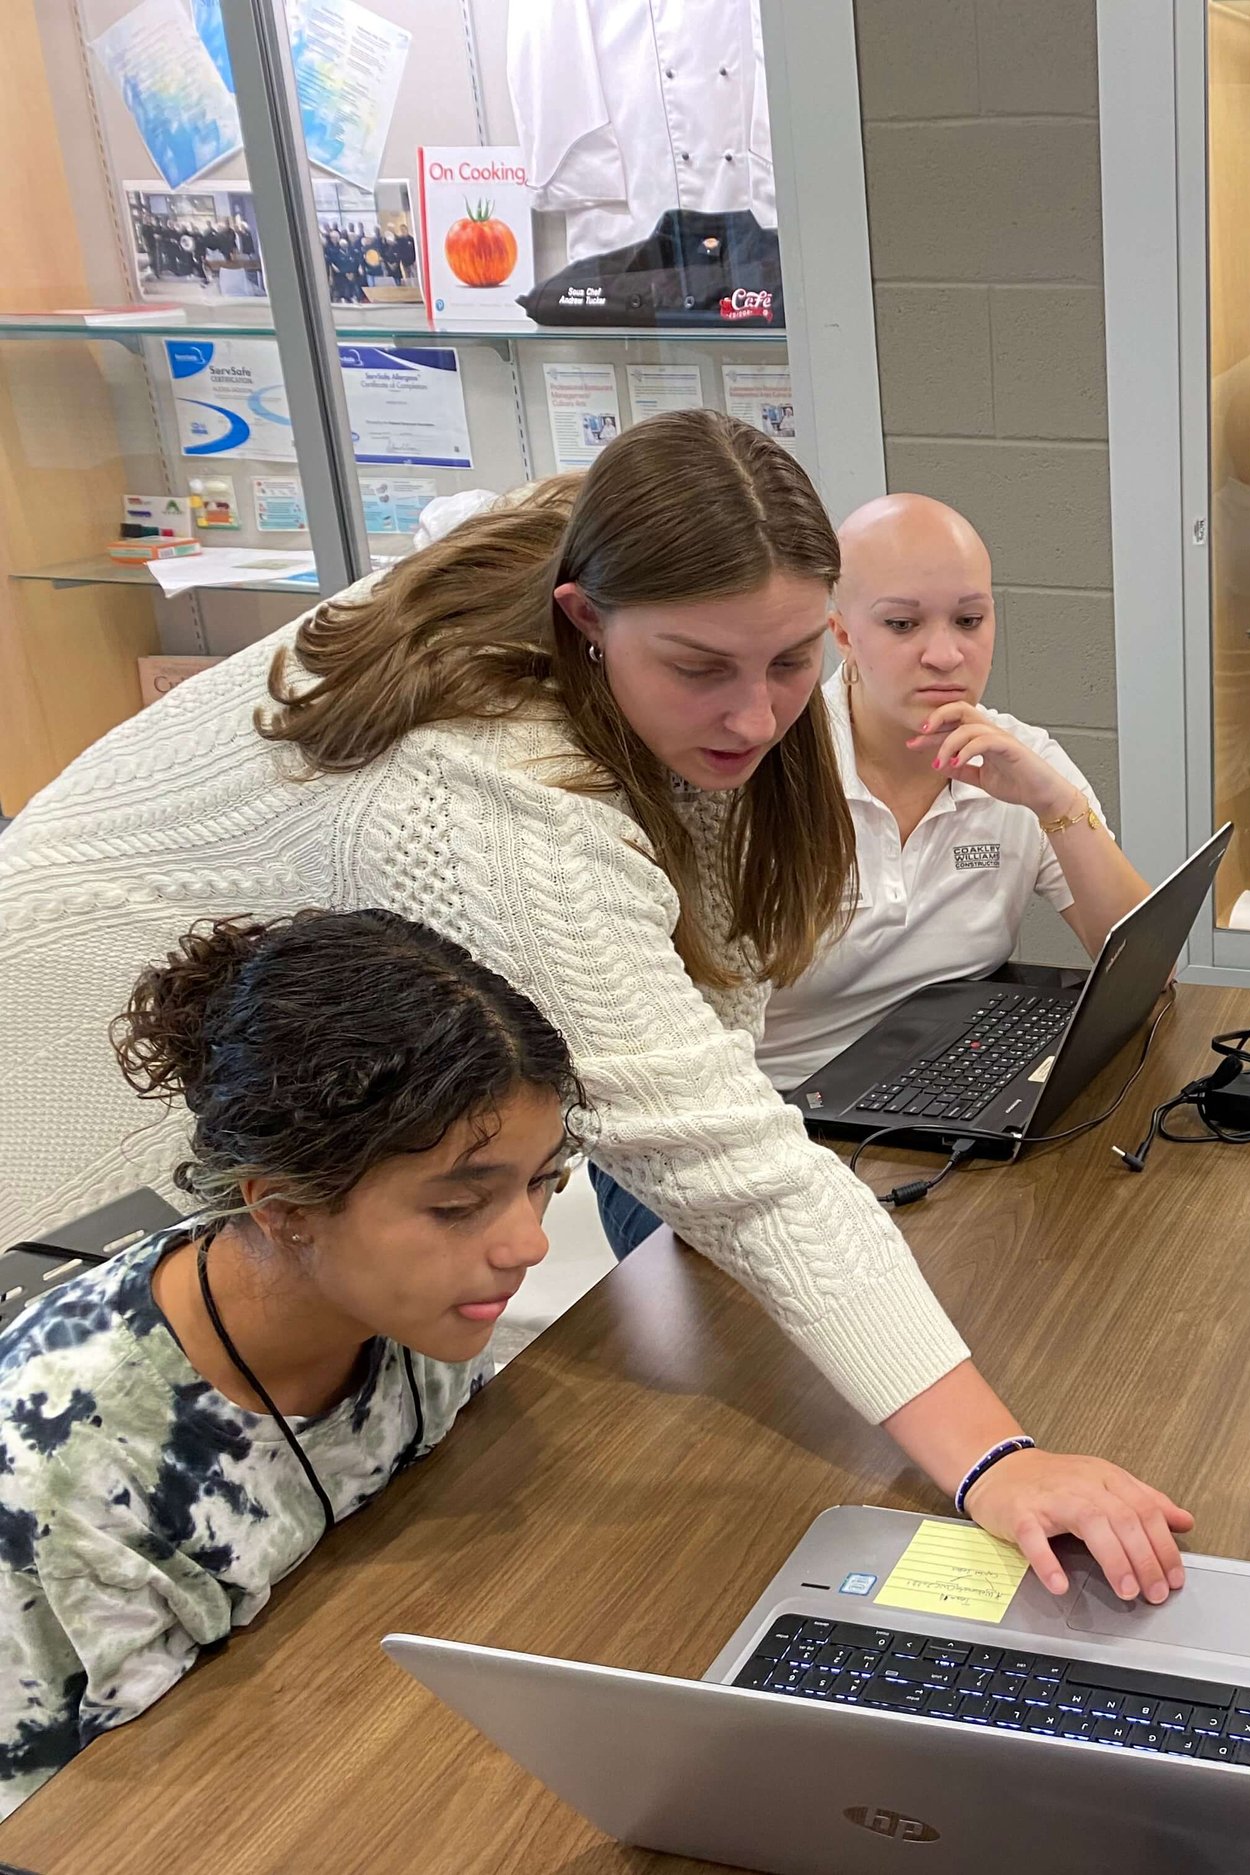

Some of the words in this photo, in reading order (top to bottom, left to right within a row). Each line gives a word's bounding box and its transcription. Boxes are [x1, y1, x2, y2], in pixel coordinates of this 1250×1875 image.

[429, 163, 453, 181] On
[459, 161, 526, 186] Cooking
[209, 365, 252, 377] ServSafe
[953, 846, 1000, 855] COAKLEY
